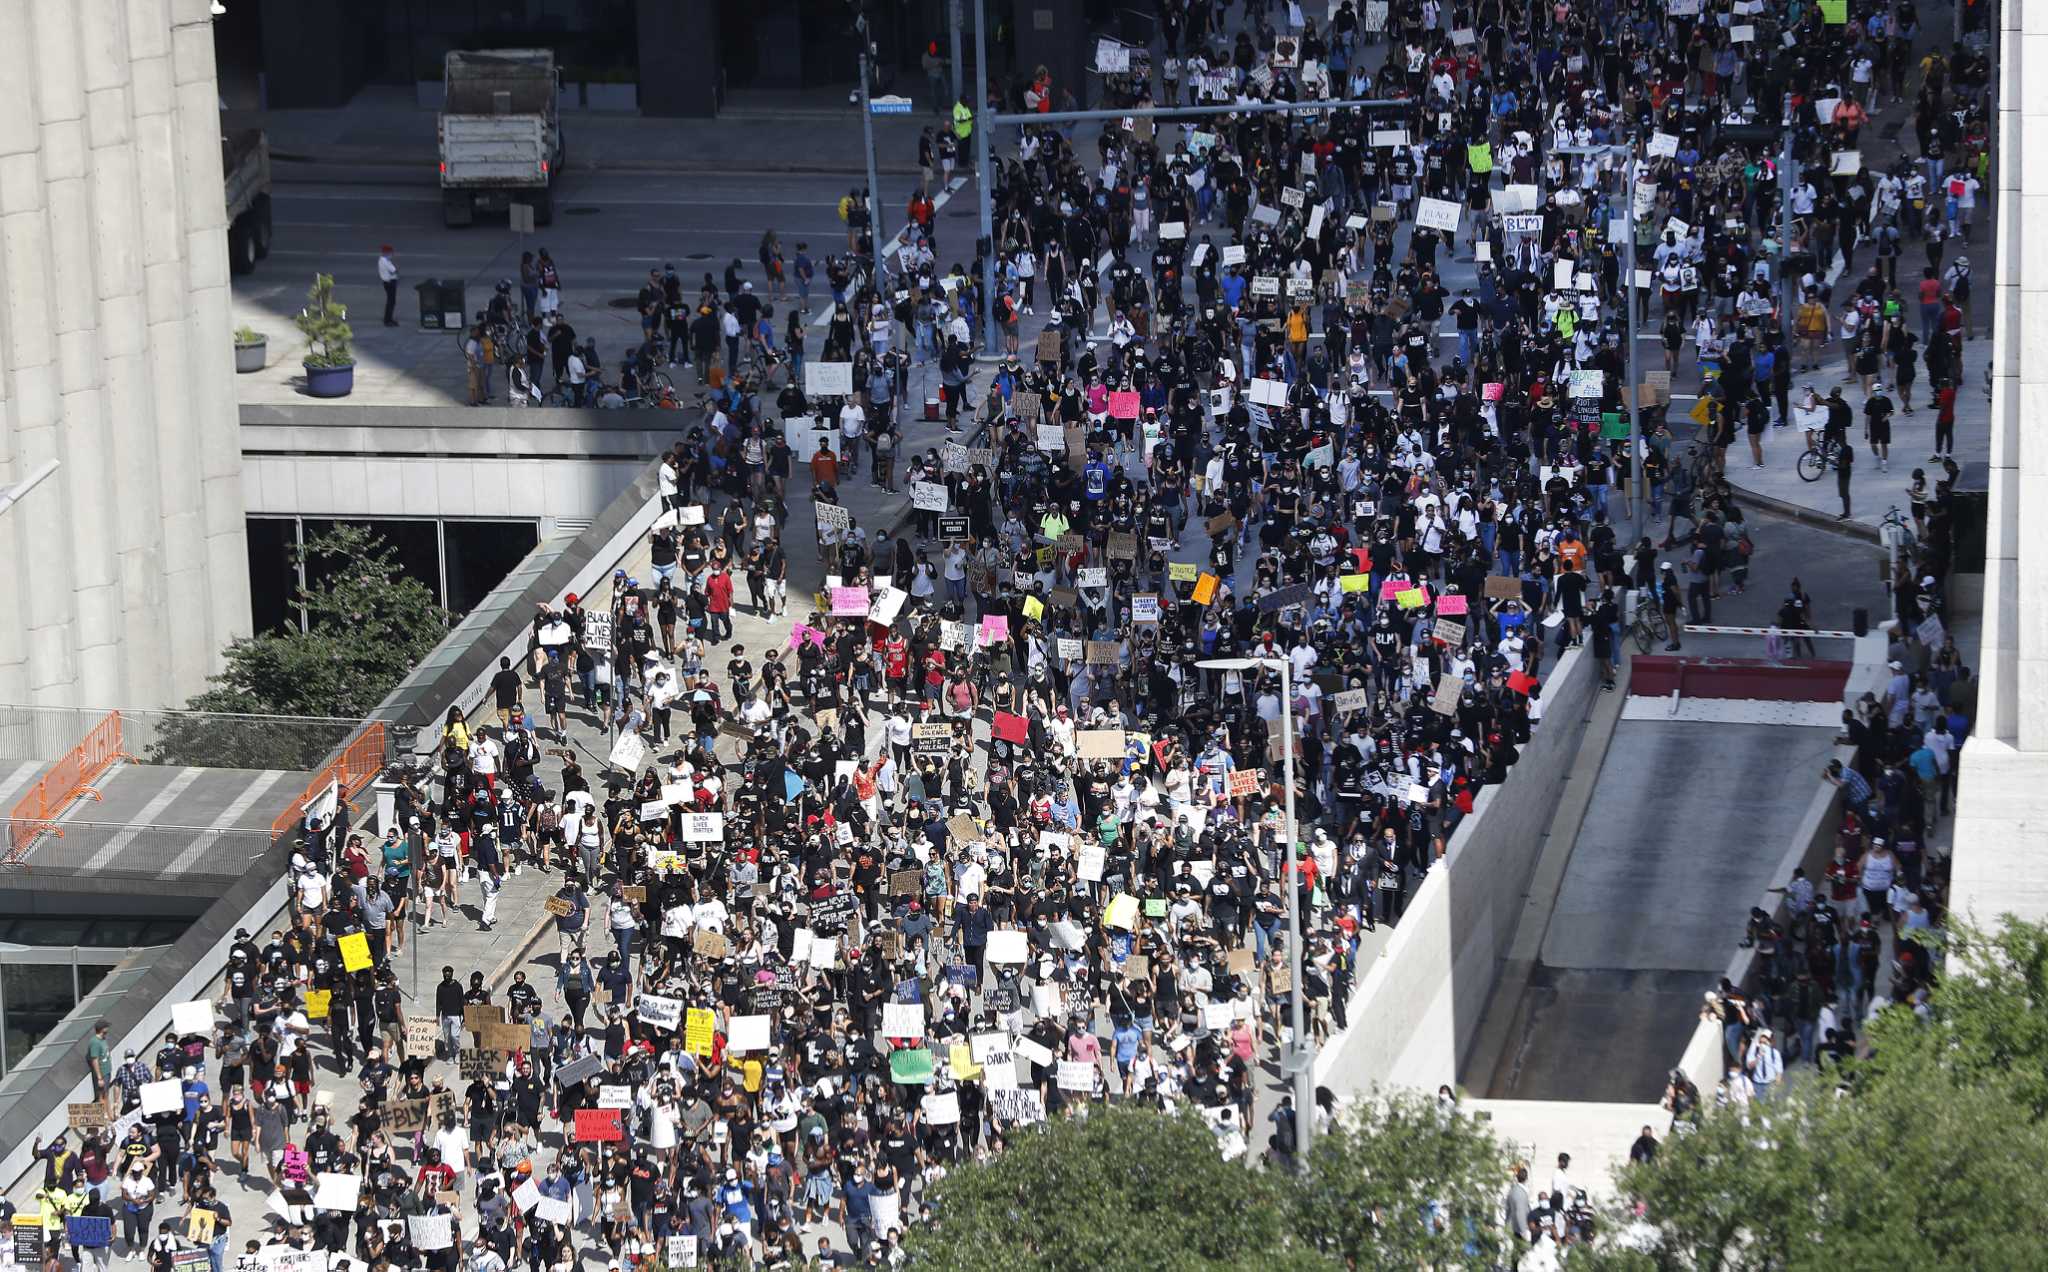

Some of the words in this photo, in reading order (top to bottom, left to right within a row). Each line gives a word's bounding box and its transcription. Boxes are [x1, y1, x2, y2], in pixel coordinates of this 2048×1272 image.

[872, 103, 912, 113] Louisiana
[1506, 216, 1541, 231] BLM
[817, 503, 846, 515] BLACK
[819, 511, 848, 523] LIVES
[1017, 572, 1031, 580] WE
[586, 610, 612, 624] BLACK
[586, 623, 612, 636] LIVES
[585, 635, 612, 647] MATTER
[1375, 632, 1394, 645] BLM
[1090, 655, 1114, 663] MATTER
[919, 723, 944, 731] WHITE
[920, 728, 949, 737] SILENCE
[918, 743, 950, 751] VIOLENCE
[1228, 769, 1257, 780] BLACK
[1231, 777, 1257, 787] LIVES
[1230, 785, 1258, 796] MATTER
[504, 812, 515, 827] 11
[829, 894, 850, 905] NEVER
[1060, 981, 1086, 991] OLOR
[1067, 991, 1082, 1001] NOT
[1083, 991, 1091, 1000] A
[1061, 1000, 1090, 1014] EAPON
[408, 1025, 428, 1034] FOR
[409, 1034, 434, 1043] BLACK
[459, 1048, 501, 1063] BLACK
[986, 1052, 1012, 1066] DARK
[994, 1089, 1006, 1100] NO
[291, 1152, 300, 1161] I
[235, 1256, 268, 1272] Justice
